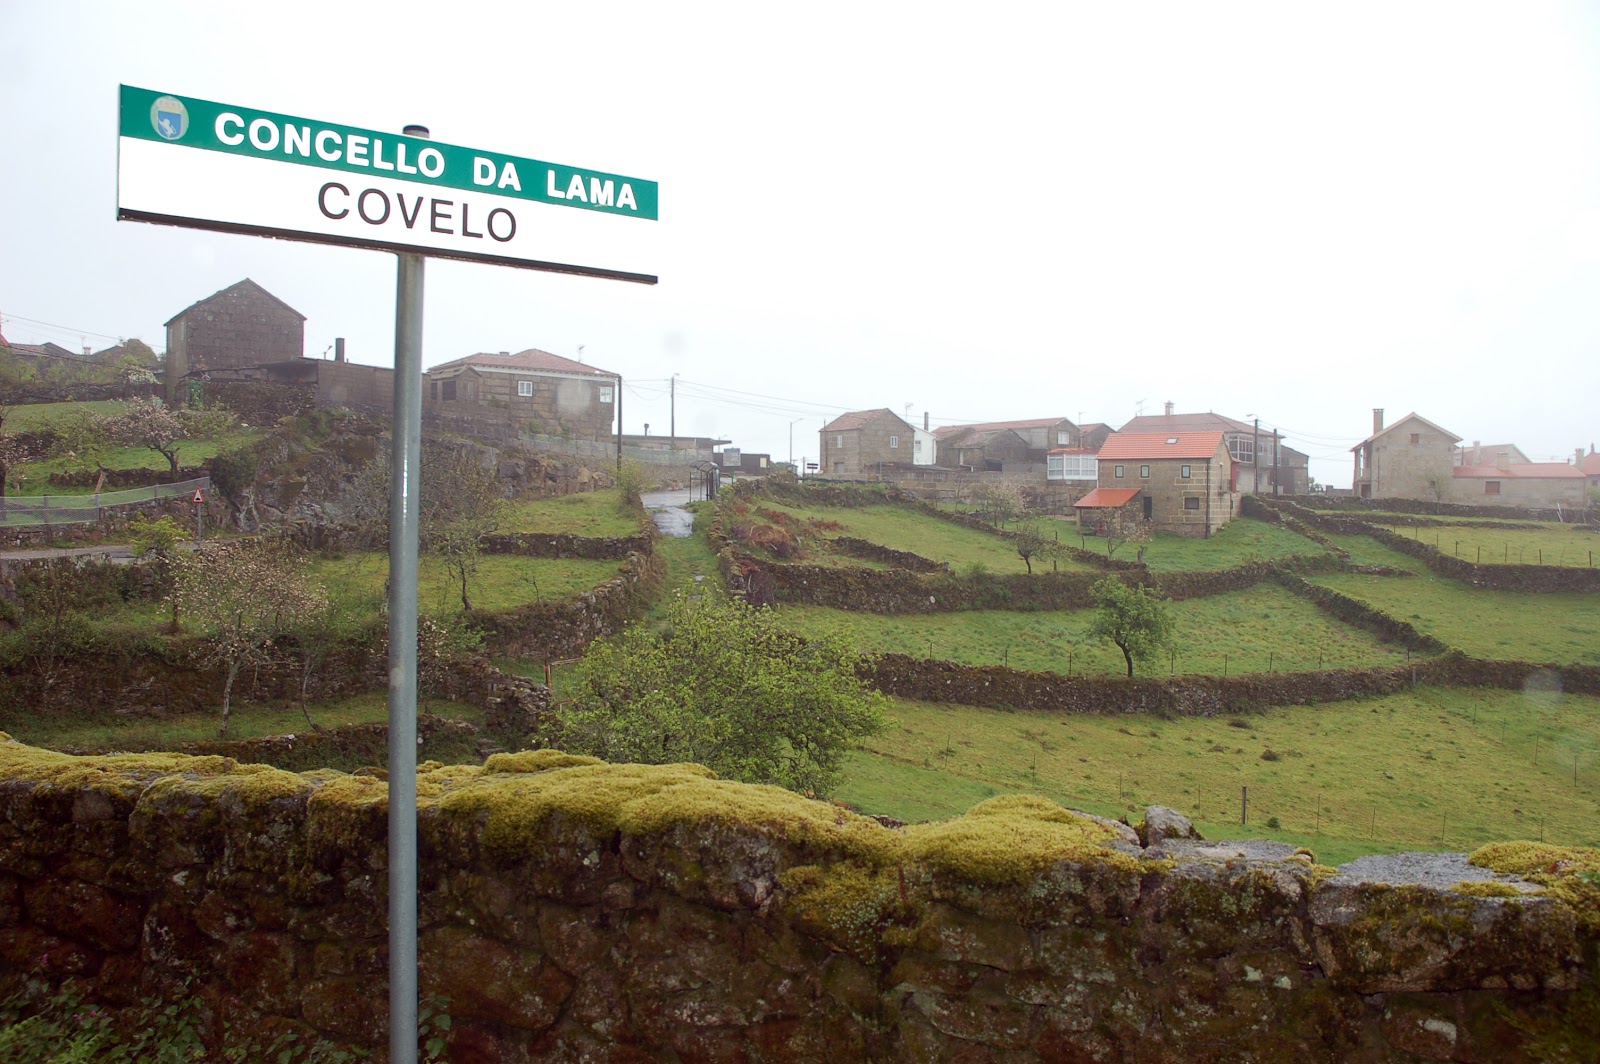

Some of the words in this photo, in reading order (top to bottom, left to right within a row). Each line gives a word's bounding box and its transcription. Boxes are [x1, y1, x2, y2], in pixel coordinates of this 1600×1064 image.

[214, 111, 446, 179] CONCELLO
[473, 156, 522, 192] DA
[546, 169, 638, 211] LAMA
[318, 182, 517, 242] COVELO
